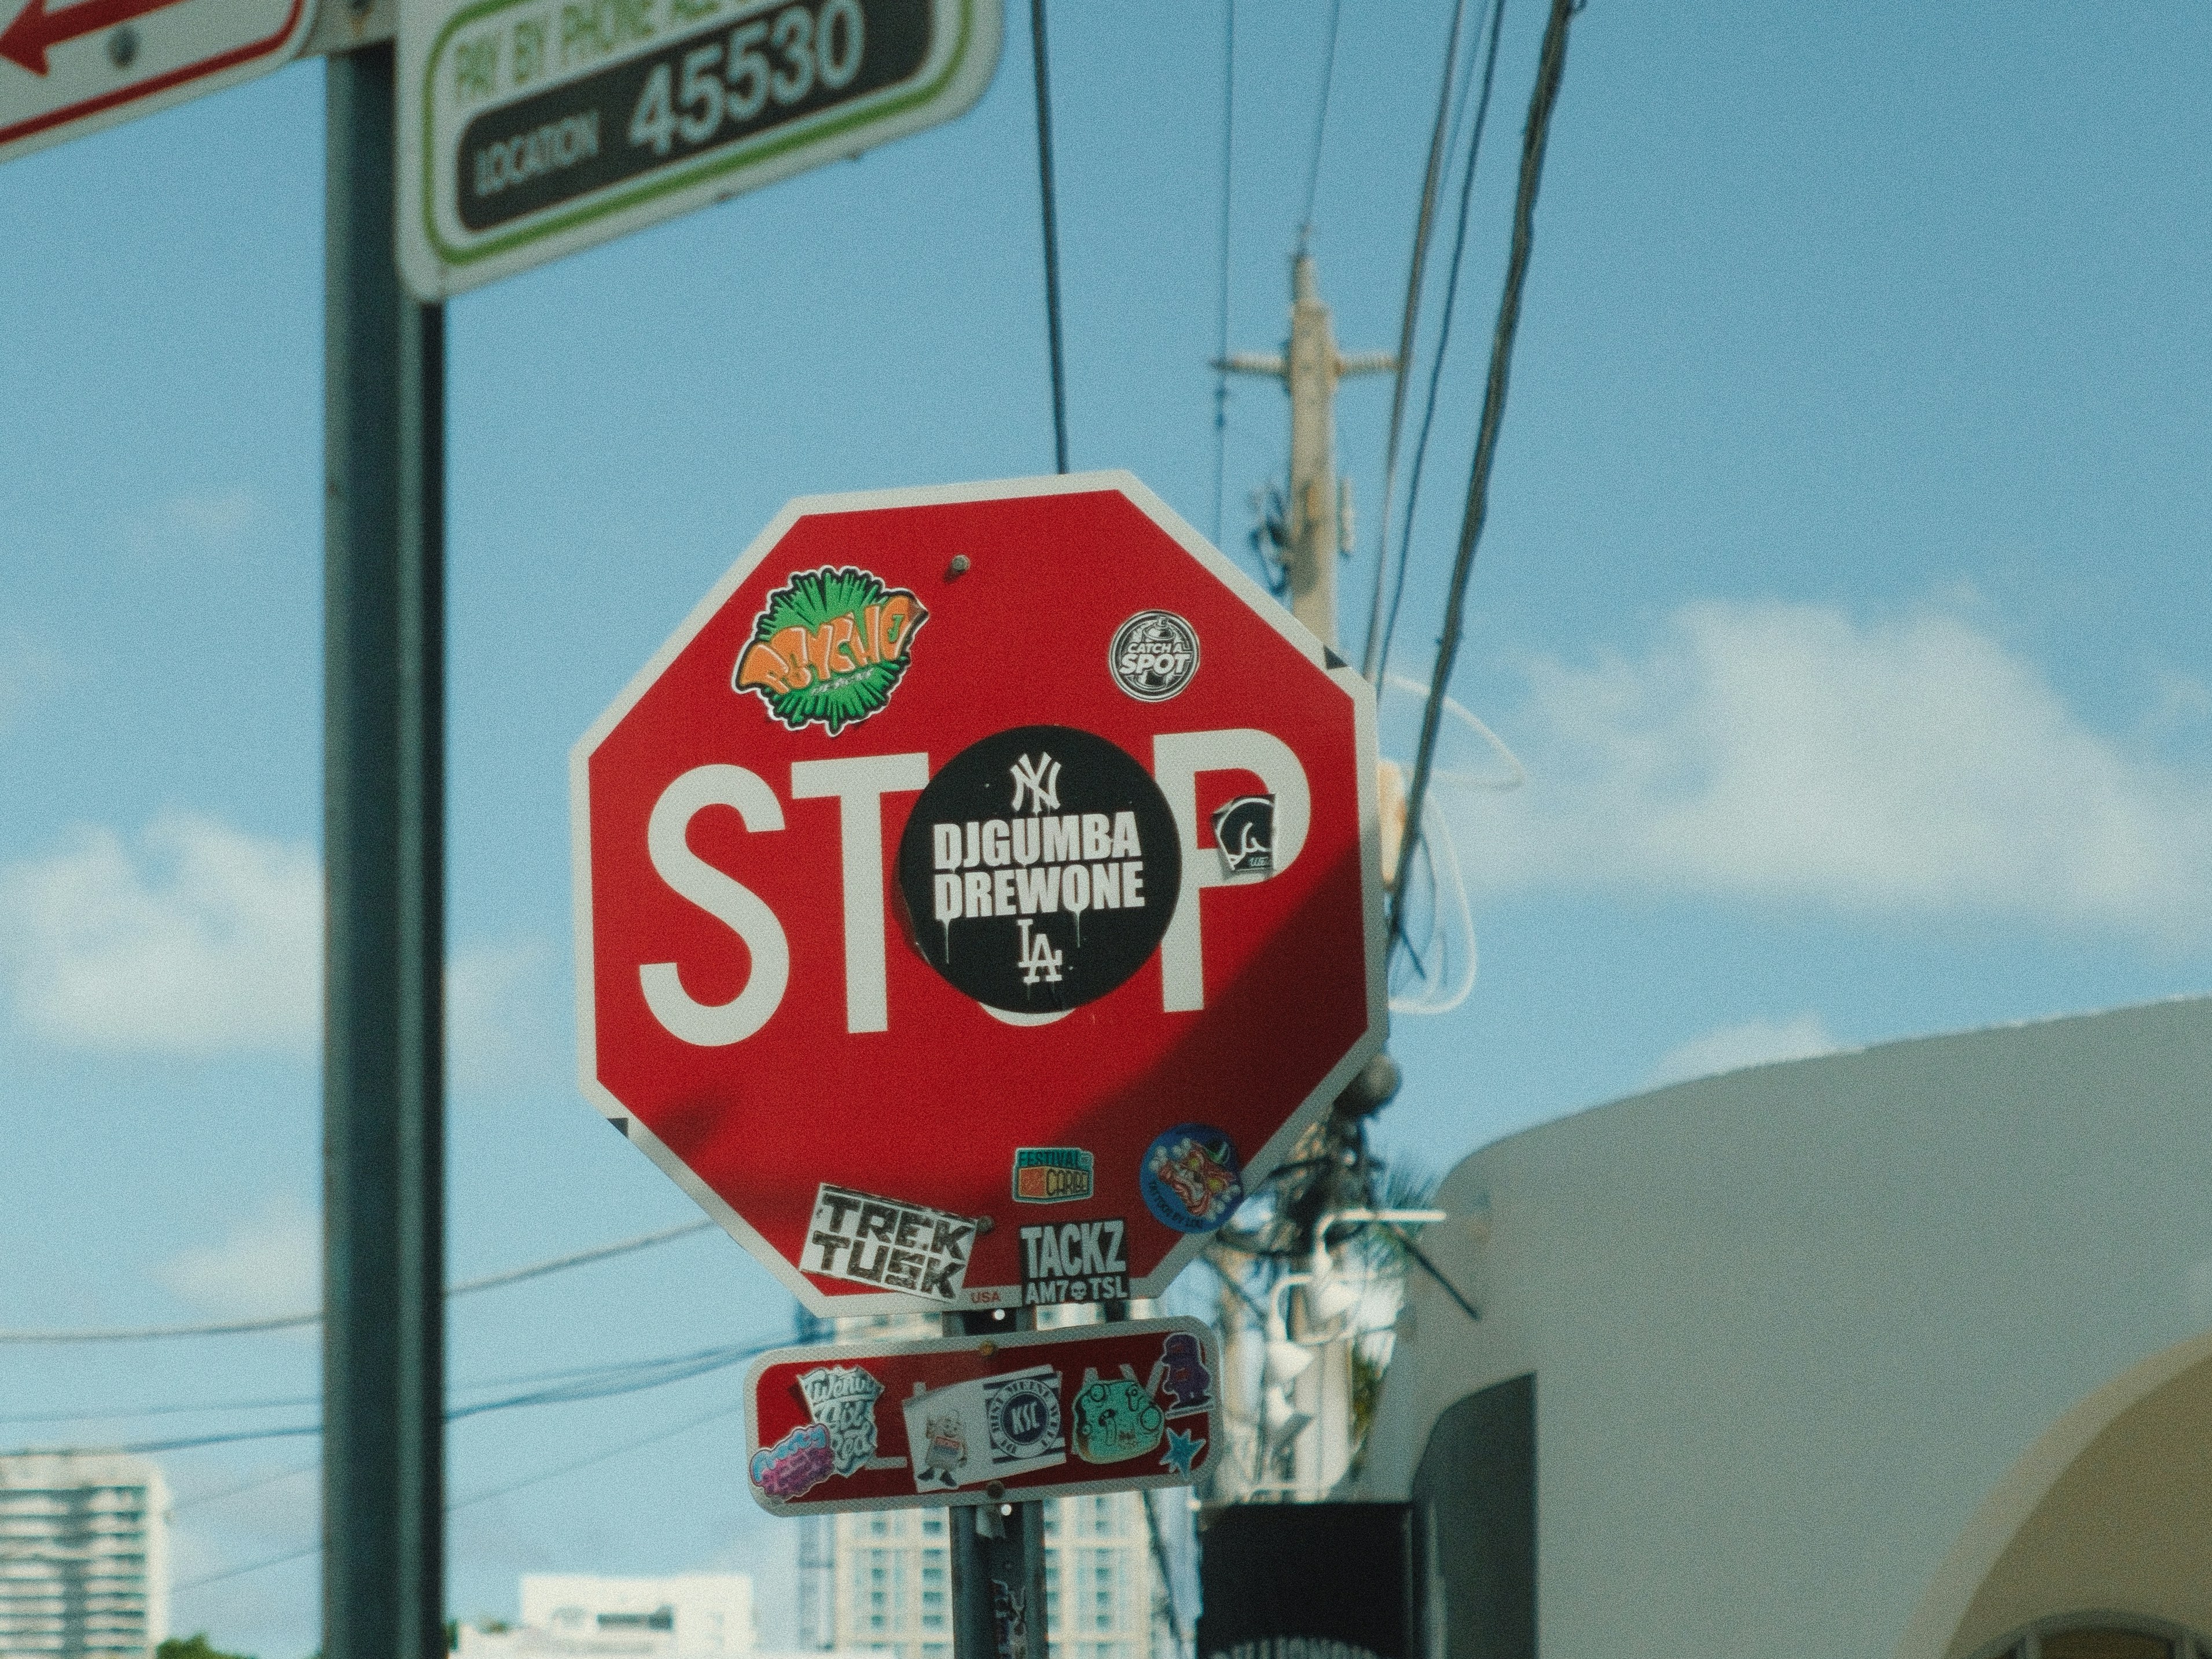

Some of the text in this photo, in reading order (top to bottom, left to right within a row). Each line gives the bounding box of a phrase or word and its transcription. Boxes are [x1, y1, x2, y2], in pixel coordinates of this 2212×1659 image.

[454, 36, 500, 105] PAY
[512, 17, 548, 84] BY
[628, 0, 866, 155] 45530
[475, 113, 601, 196] LOCATION
[1119, 653, 1190, 674] SPOT
[1128, 643, 1184, 654] CATCH A
[932, 811, 1141, 870] DJGUMBA
[639, 728, 1311, 1047] STP
[934, 861, 1145, 922] DREWONE
[1019, 1150, 1081, 1169] FESTIVAL
[822, 1191, 976, 1261] TREK
[1020, 1219, 1126, 1278] TACKZ
[971, 1291, 1001, 1303] USA
[1011, 1401, 1041, 1435] KSC
